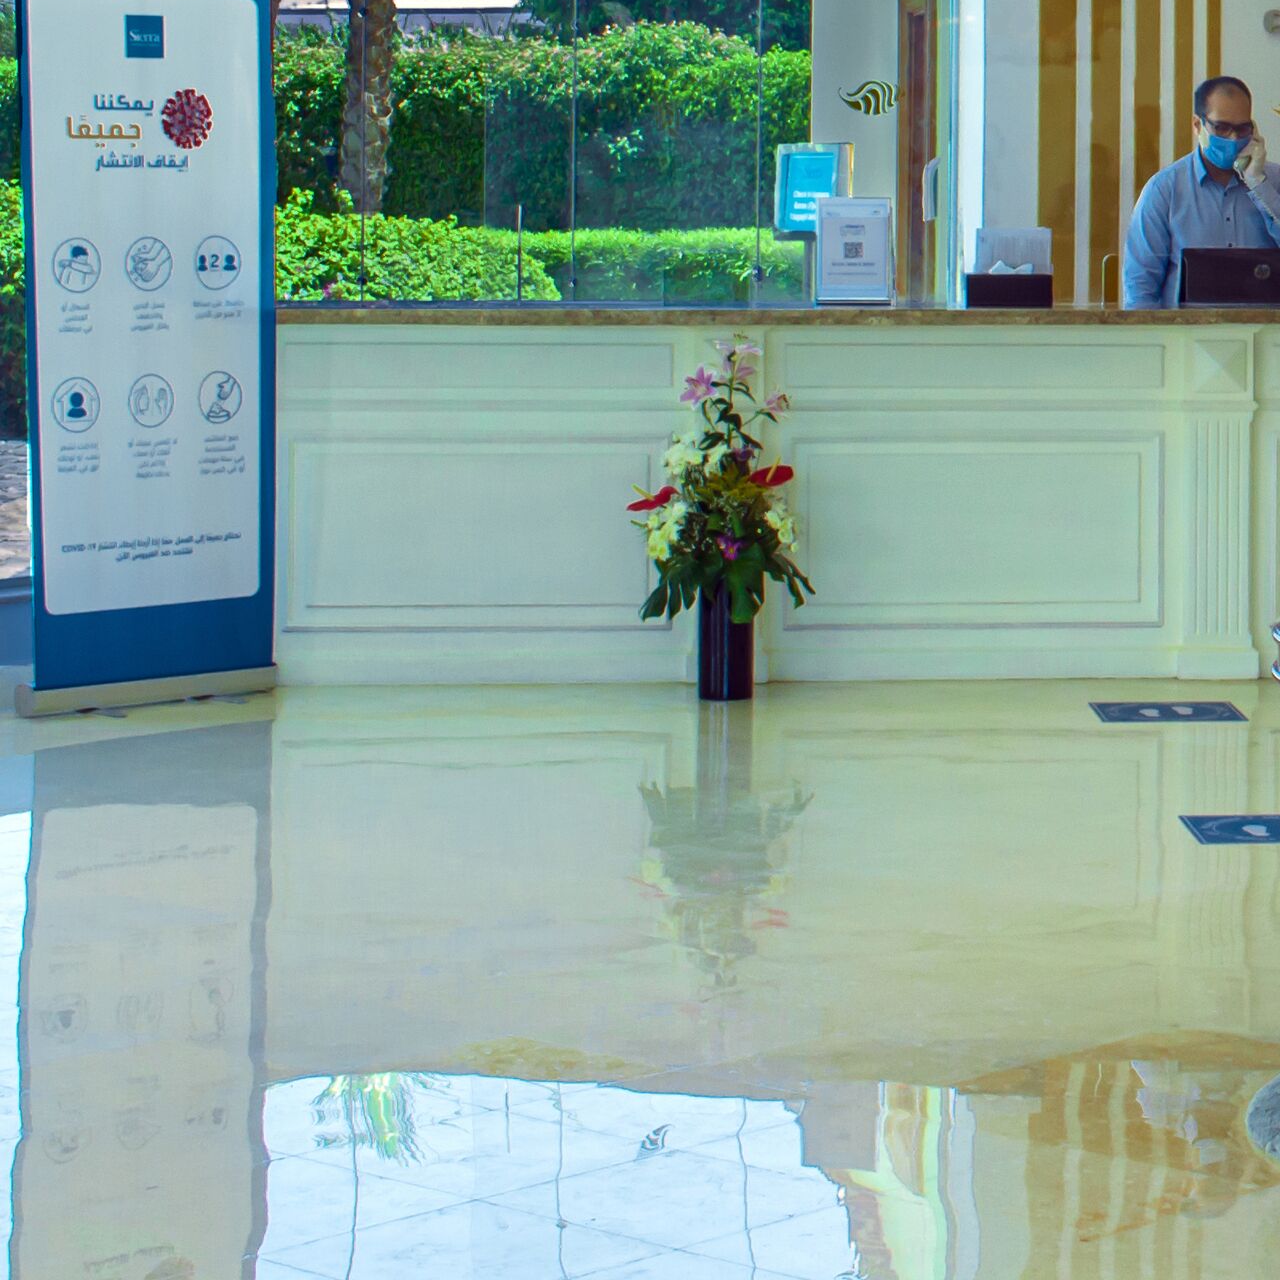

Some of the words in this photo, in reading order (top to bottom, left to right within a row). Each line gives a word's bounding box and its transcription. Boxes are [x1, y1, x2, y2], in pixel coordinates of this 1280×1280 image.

[94, 94, 154, 116] يمكننا
[96, 151, 144, 172] الانتشار
[211, 253, 219, 268] 2
